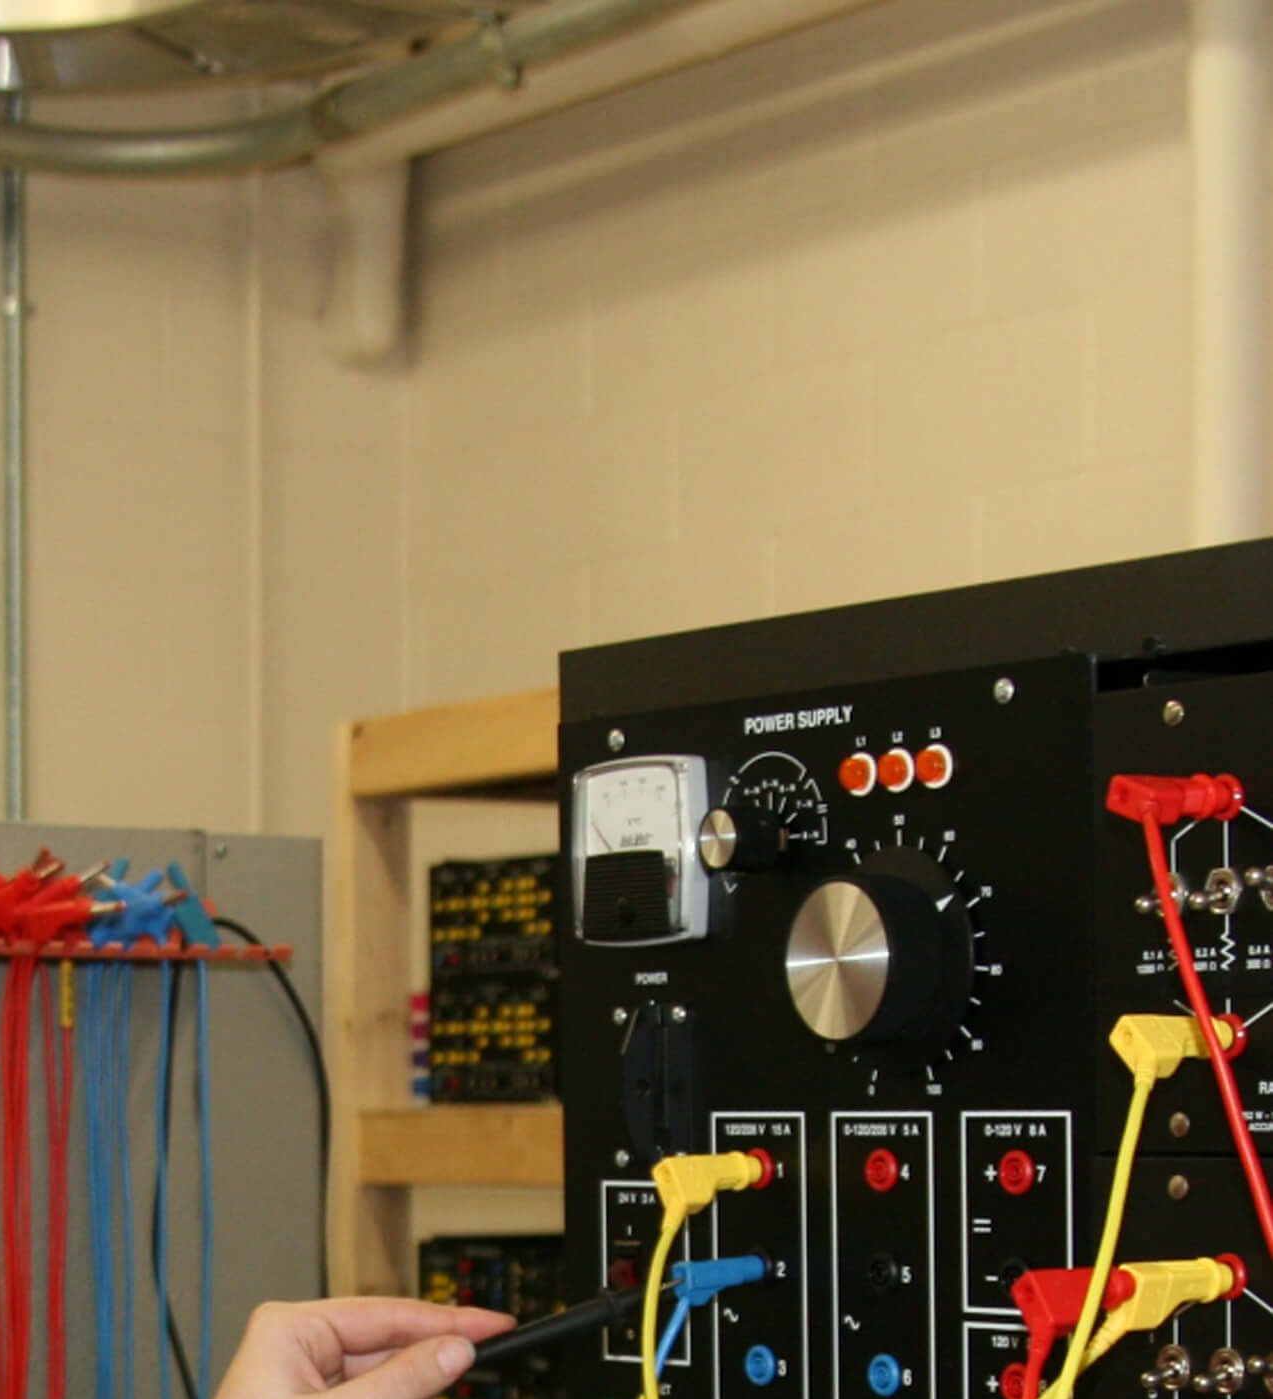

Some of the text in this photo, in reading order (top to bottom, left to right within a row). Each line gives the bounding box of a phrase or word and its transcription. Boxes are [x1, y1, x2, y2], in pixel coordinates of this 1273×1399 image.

[745, 706, 852, 734] POWER SUPPLY
[635, 971, 668, 985] POWER
[782, 1123, 791, 1135] A
[910, 1123, 920, 1136] A
[1013, 1123, 1023, 1136] V
[1037, 1123, 1047, 1136] A
[776, 1161, 784, 1178] 1
[900, 1163, 910, 1180] 4
[1035, 1164, 1047, 1183] 7
[776, 1260, 786, 1278] 2
[901, 1265, 912, 1284] 5
[777, 1359, 787, 1377] 3
[902, 1368, 913, 1386] 6
